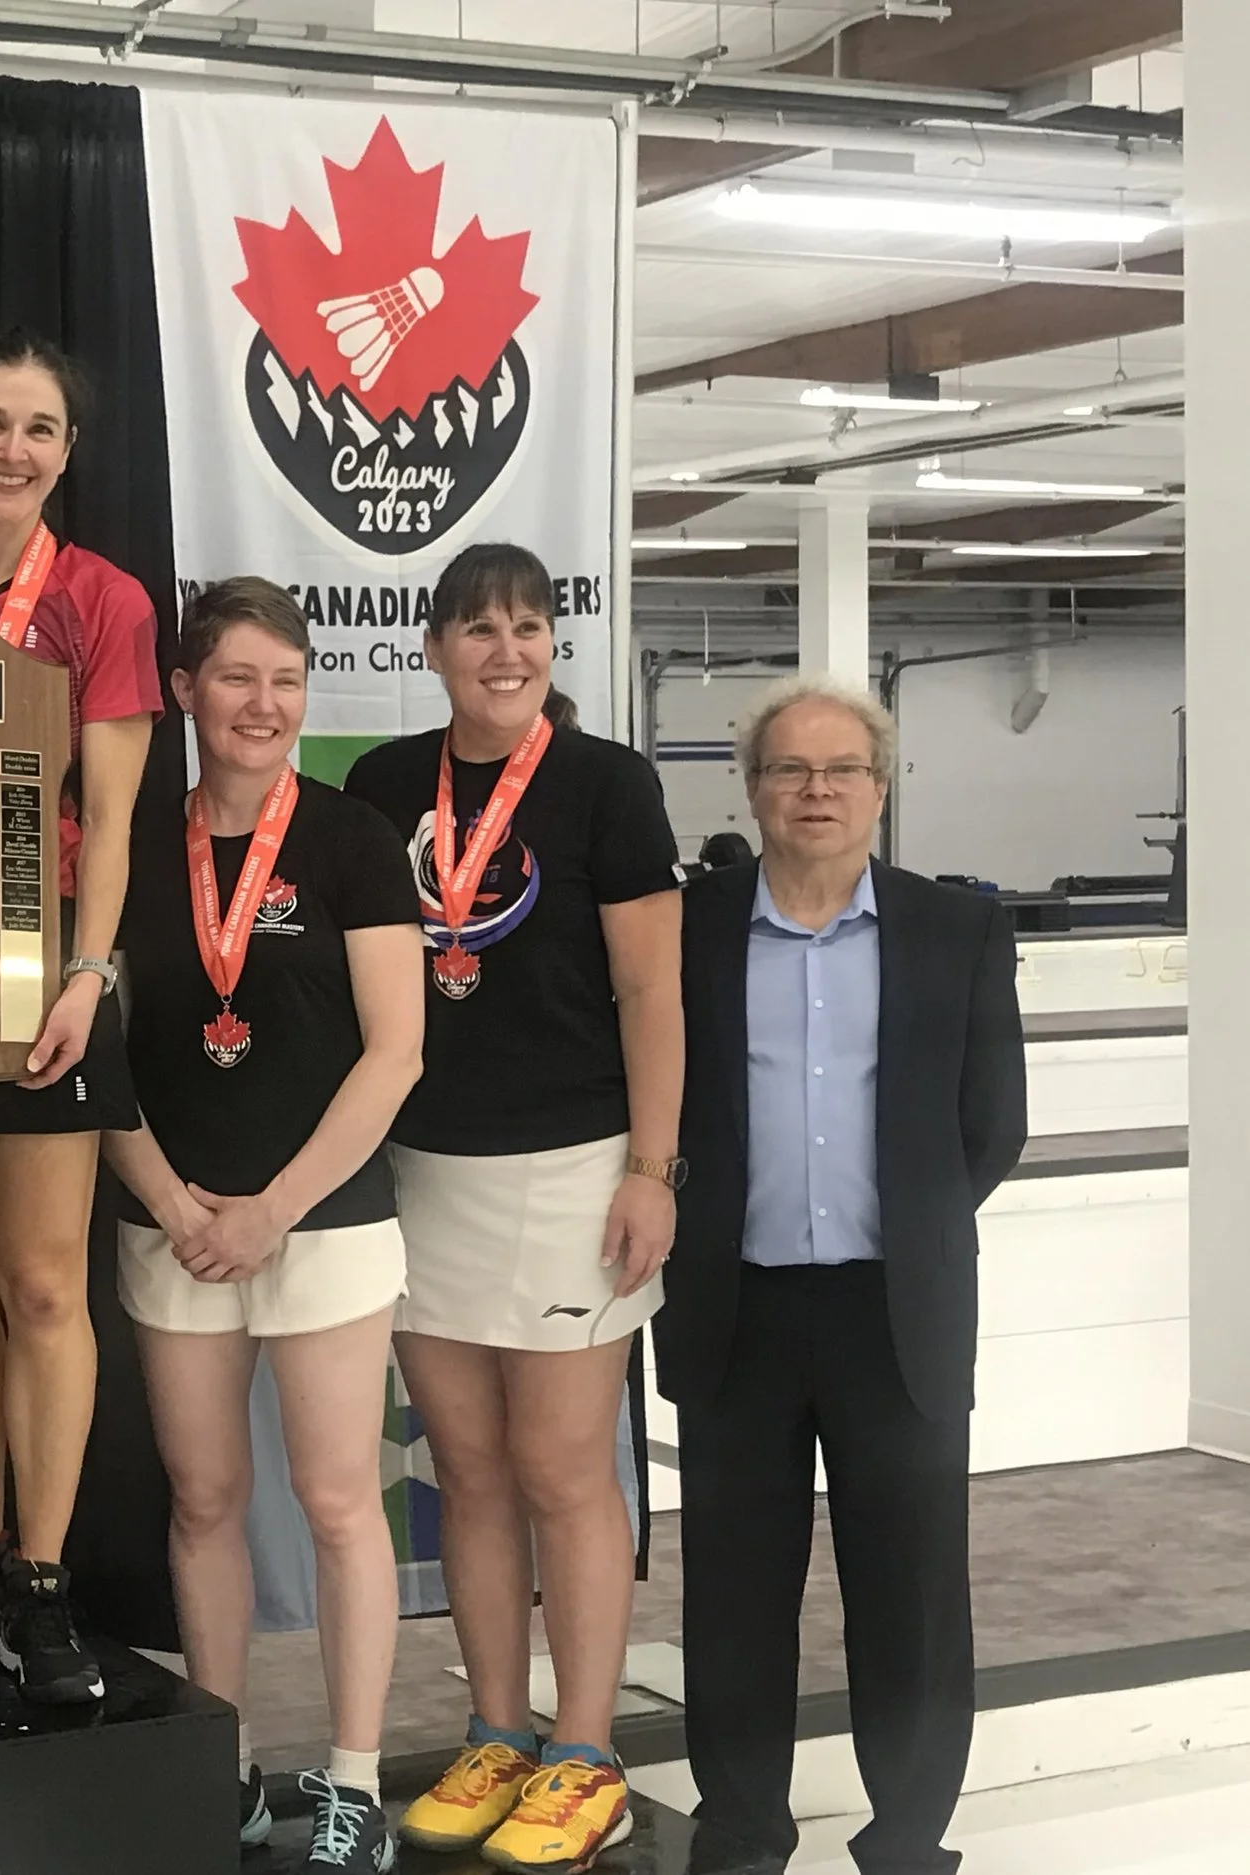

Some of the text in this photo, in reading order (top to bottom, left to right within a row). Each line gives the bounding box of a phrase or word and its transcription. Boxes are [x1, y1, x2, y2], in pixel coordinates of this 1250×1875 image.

[331, 445, 455, 510] Calgary
[358, 500, 431, 532] 2023
[906, 761, 914, 774] 2
[453, 864, 470, 893] YONEX
[466, 828, 488, 865] CANADIAN
[484, 797, 505, 830] MASTERS
[220, 856, 261, 957] YONEX CANADIAN MASTERS
